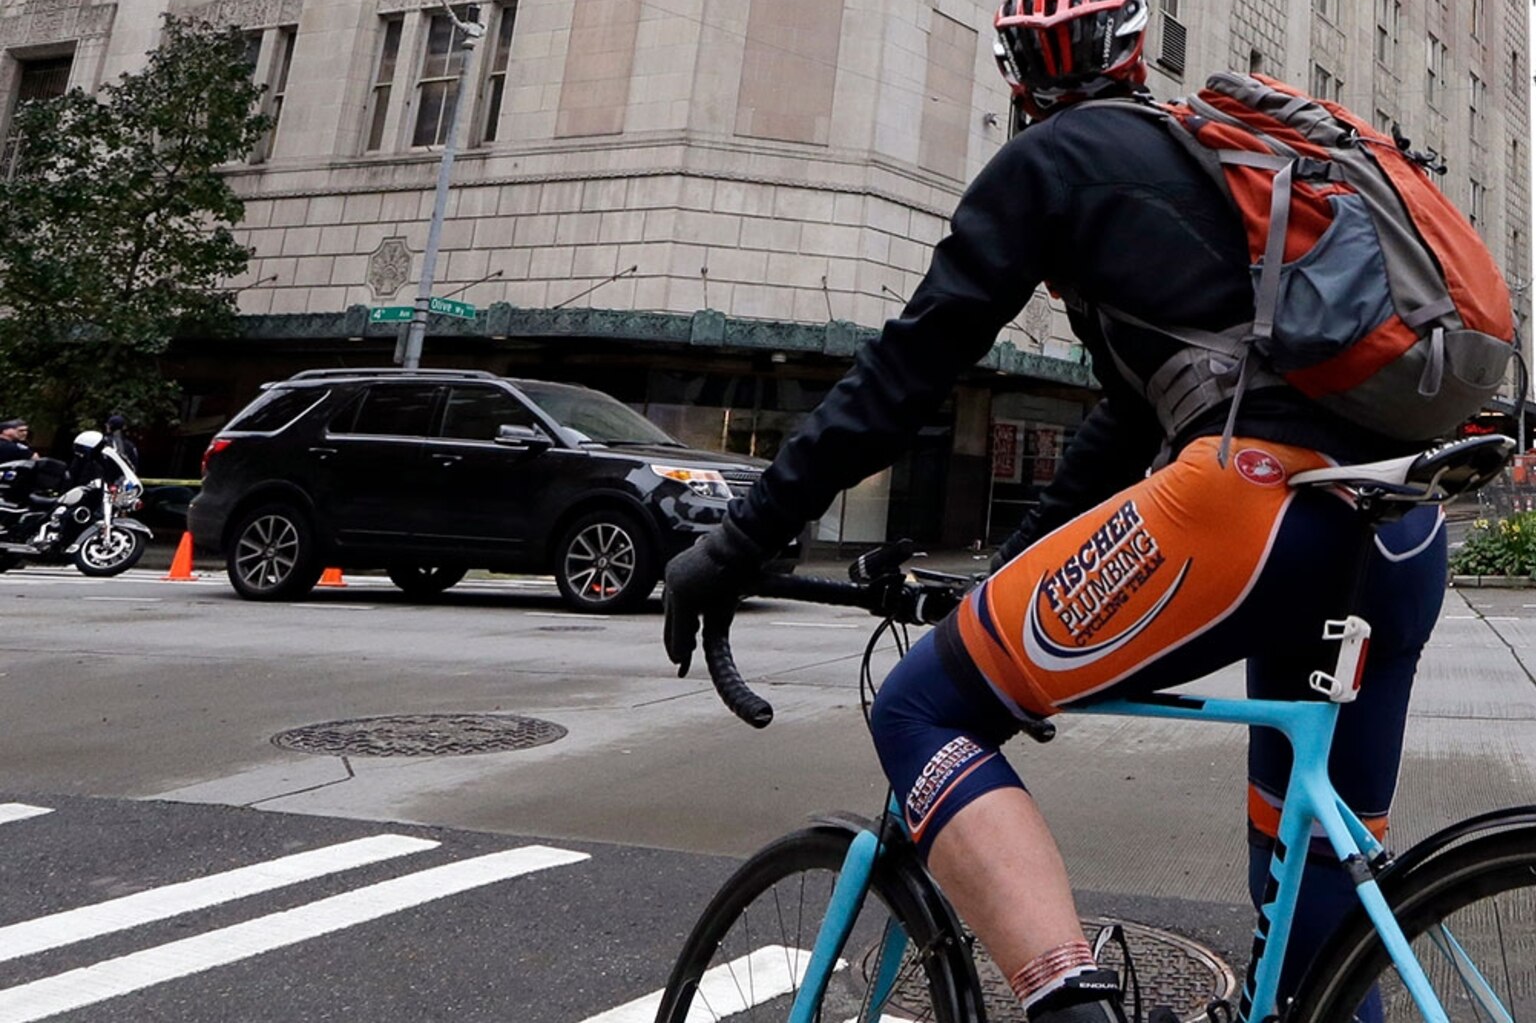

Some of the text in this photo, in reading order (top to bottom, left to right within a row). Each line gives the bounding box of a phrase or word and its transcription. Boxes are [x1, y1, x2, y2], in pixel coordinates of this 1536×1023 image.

[1041, 500, 1144, 613] FISCHER
[1058, 529, 1160, 636] PLUMBING
[1074, 553, 1165, 647] CYCLING TEAM
[906, 736, 969, 808] FISCHER
[913, 741, 982, 815] PLUMBING
